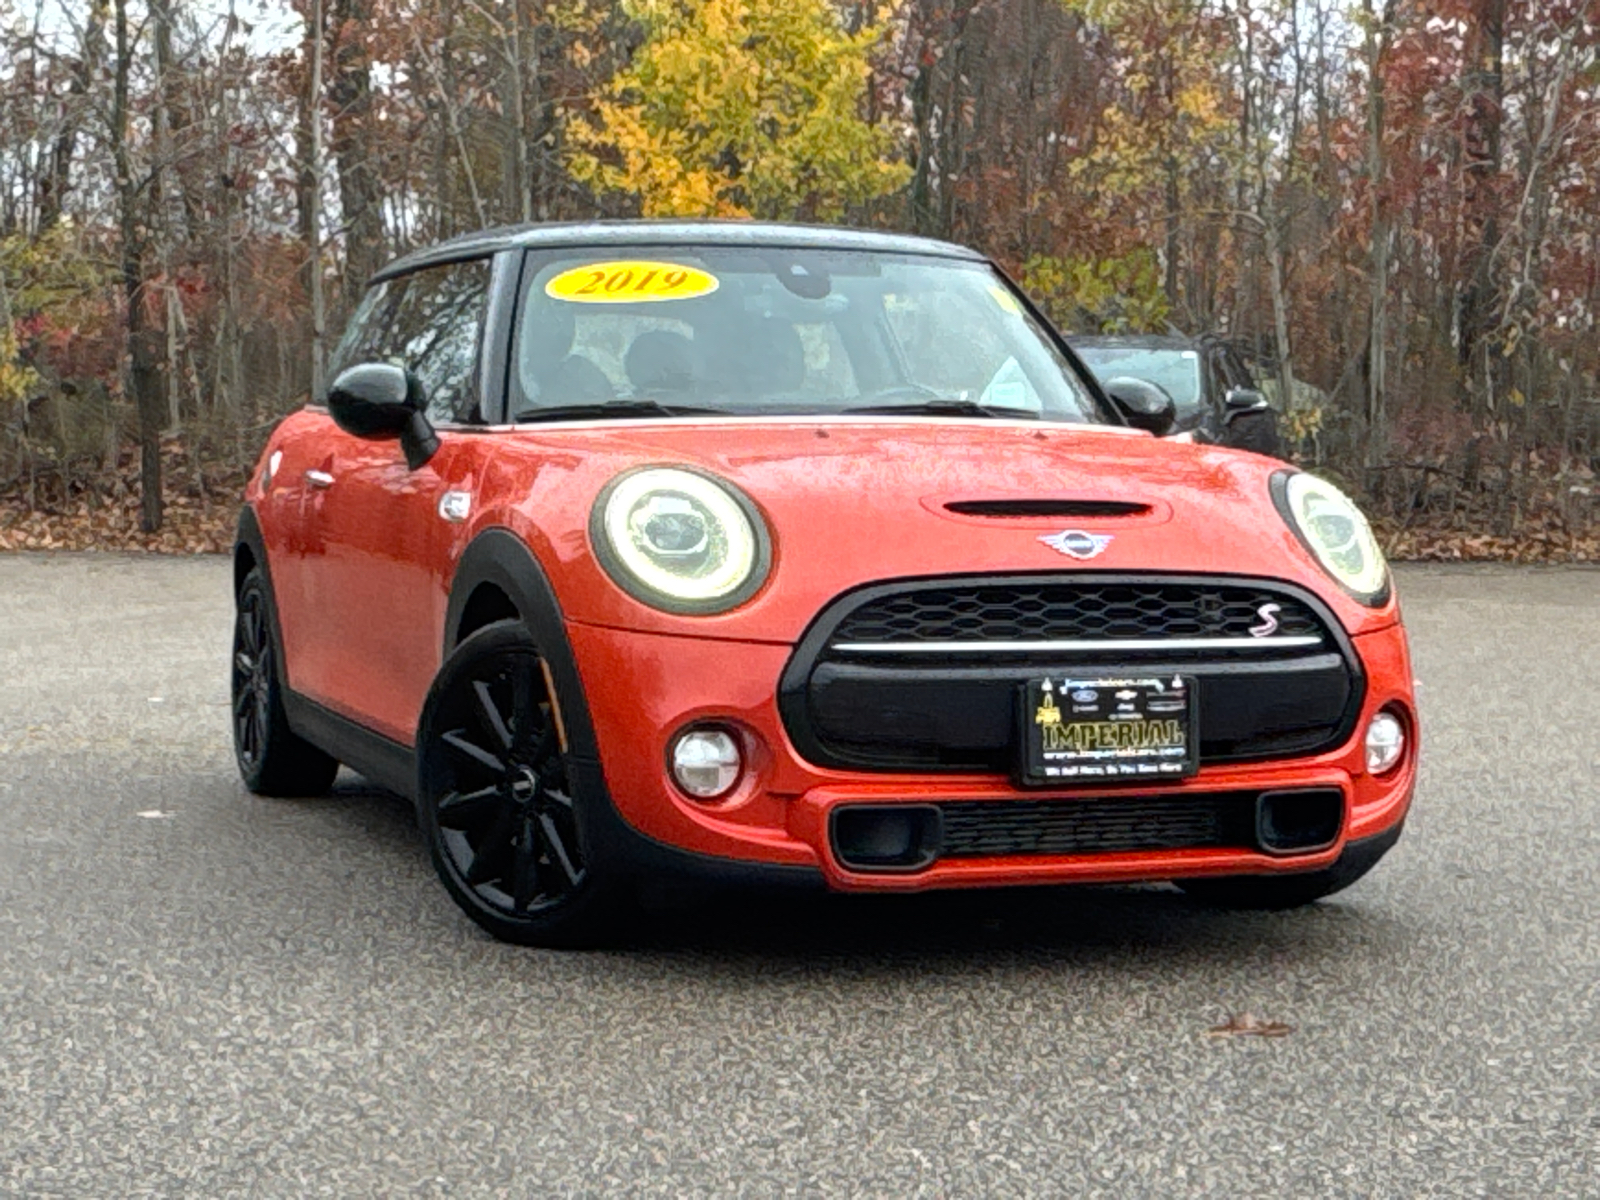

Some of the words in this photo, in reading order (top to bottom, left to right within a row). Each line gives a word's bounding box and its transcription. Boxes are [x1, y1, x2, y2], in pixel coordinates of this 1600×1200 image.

[575, 270, 688, 295] 2019
[1248, 603, 1281, 637] S
[1043, 720, 1185, 751] IMPERIAL
